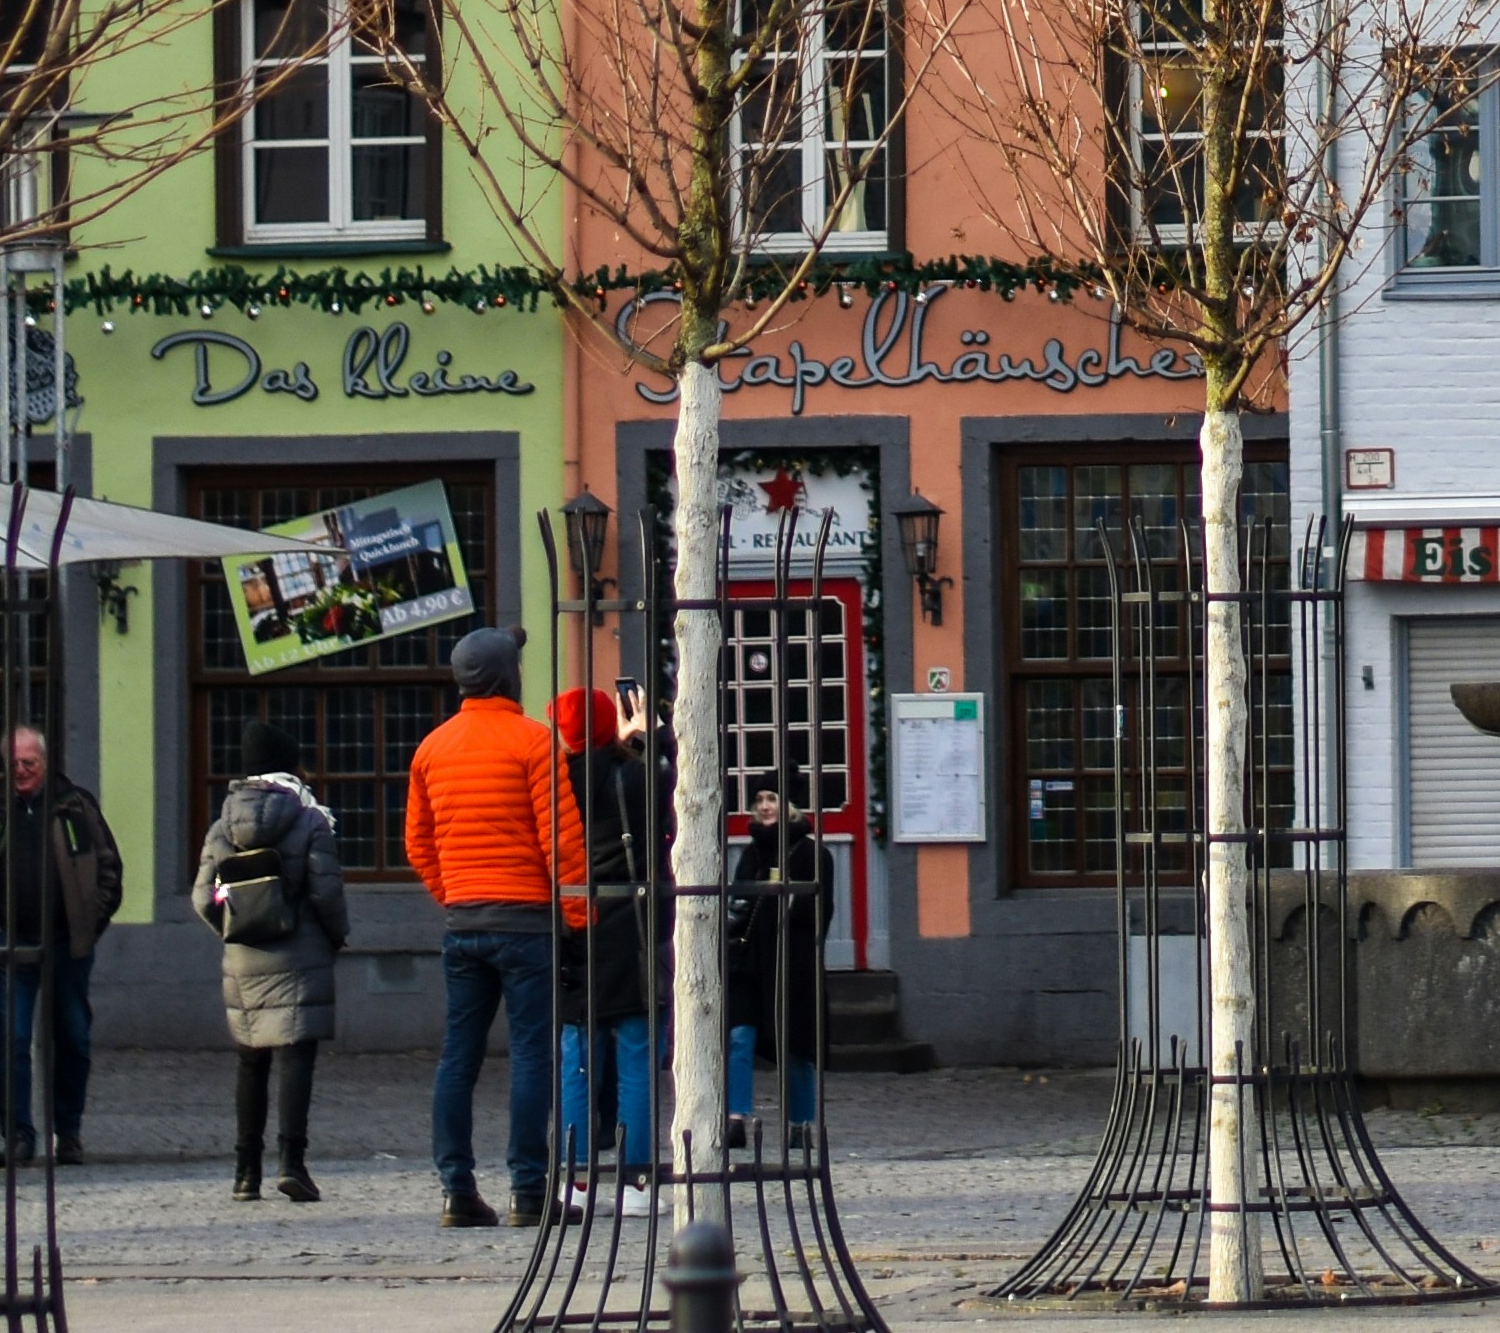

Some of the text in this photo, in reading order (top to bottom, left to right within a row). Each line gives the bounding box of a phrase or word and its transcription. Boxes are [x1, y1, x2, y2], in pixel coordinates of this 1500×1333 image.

[150, 320, 536, 406] Das kleine
[752, 529, 870, 549] REAUANT
[1410, 535, 1494, 579] Eis
[381, 605, 408, 627] Ab
[409, 593, 449, 619] 4,90
